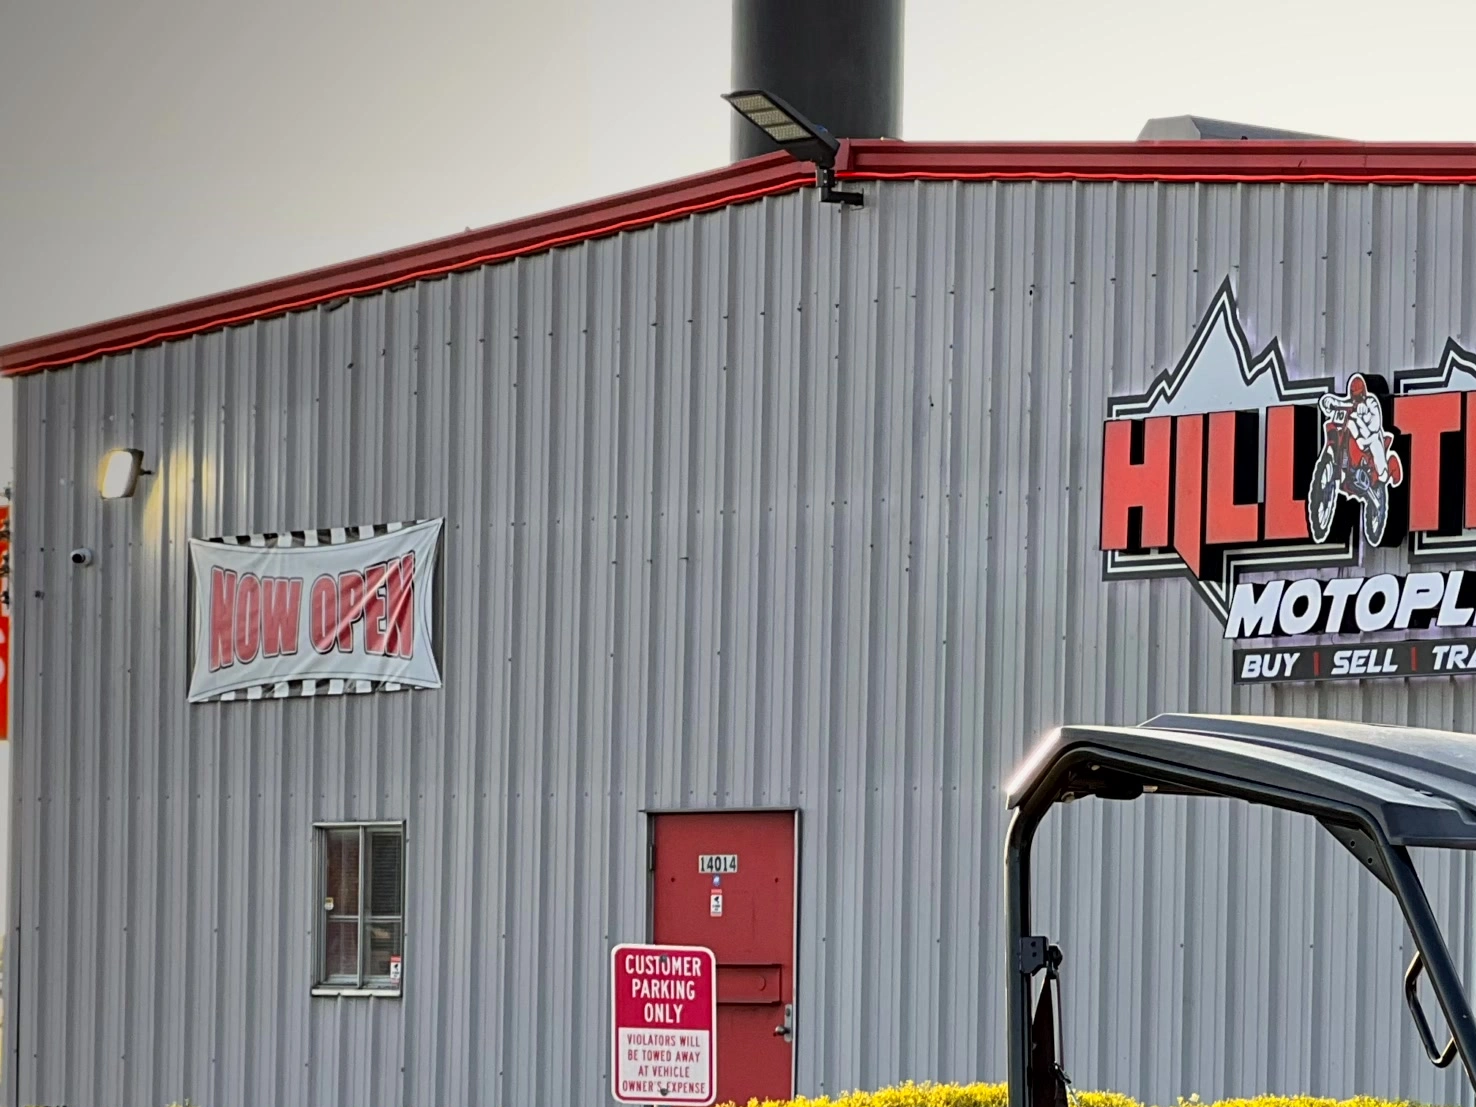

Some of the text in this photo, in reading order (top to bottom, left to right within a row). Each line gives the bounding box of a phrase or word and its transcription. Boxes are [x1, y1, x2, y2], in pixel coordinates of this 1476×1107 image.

[1101, 404, 1310, 579] HILL
[208, 550, 417, 672] NOW OPEN
[1241, 652, 1301, 679] BUY
[1331, 648, 1399, 674] SELL
[700, 855, 736, 872] 14014
[625, 954, 702, 976] CUSTOMER
[632, 978, 695, 1000] PARKING
[644, 1003, 683, 1024] ONLY
[627, 1034, 700, 1047] VIOLATORS WILL
[627, 1049, 700, 1063] BE TOWED AWAY
[638, 1065, 690, 1078] AT VEHICLE
[622, 1080, 706, 1094] OWNER'S EXPENSE
